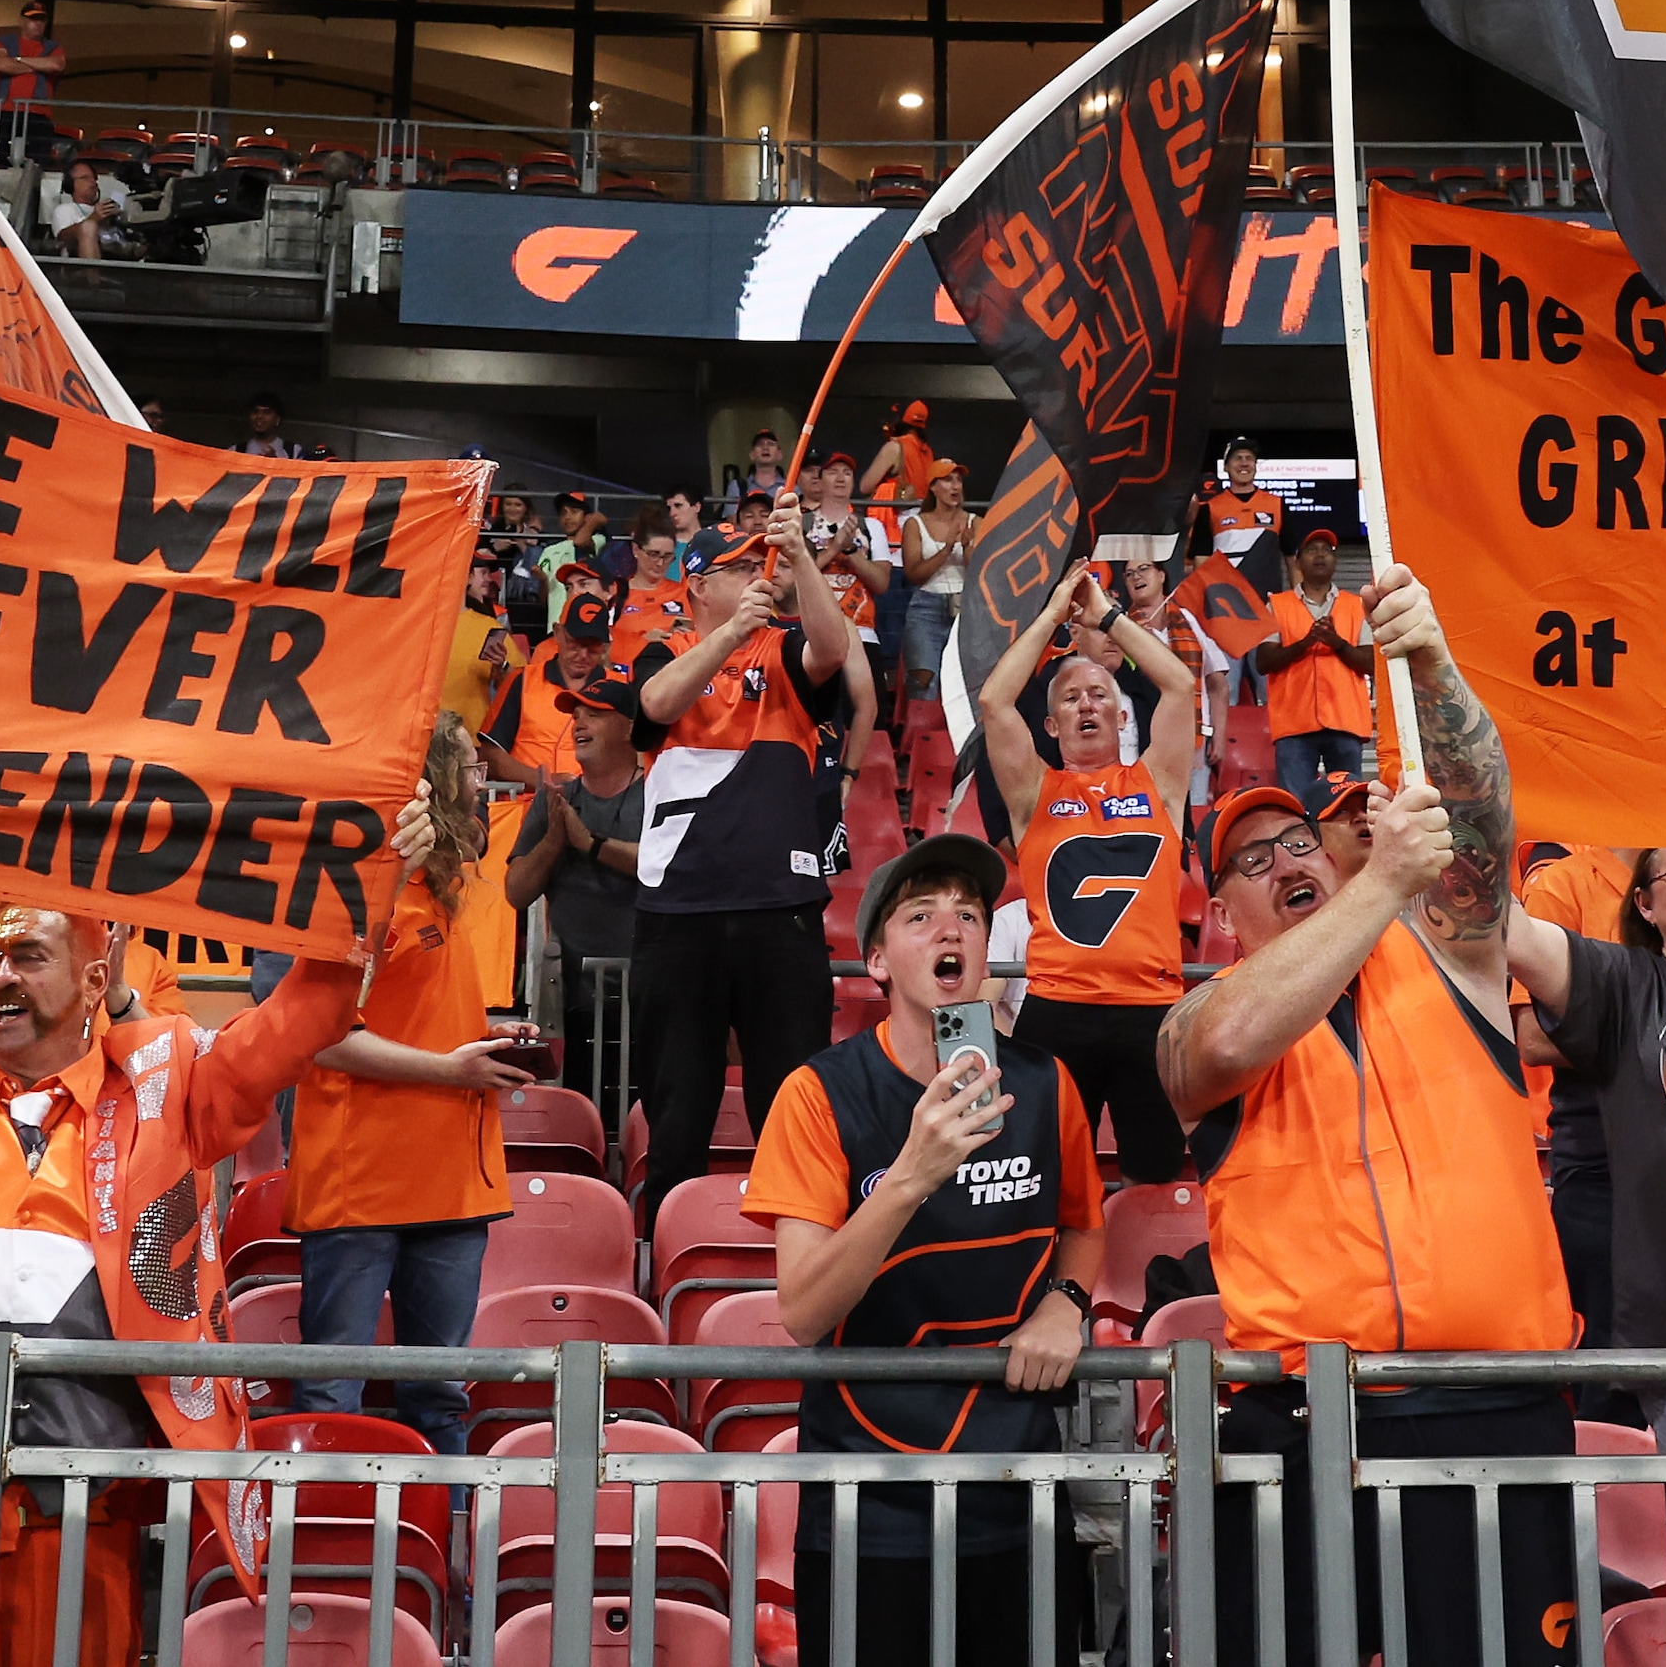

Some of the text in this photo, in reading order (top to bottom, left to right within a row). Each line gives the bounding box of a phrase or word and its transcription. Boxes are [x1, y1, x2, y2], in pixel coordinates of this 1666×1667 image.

[1409, 244, 1584, 367] The
[114, 443, 409, 600] WILL
[1533, 609, 1628, 689] at
[1051, 802, 1087, 817] AFL
[1103, 796, 1139, 808] TOYO
[1110, 805, 1150, 816] TIRES
[956, 1155, 1031, 1185] TOYO
[969, 1174, 1042, 1205] TIRES
